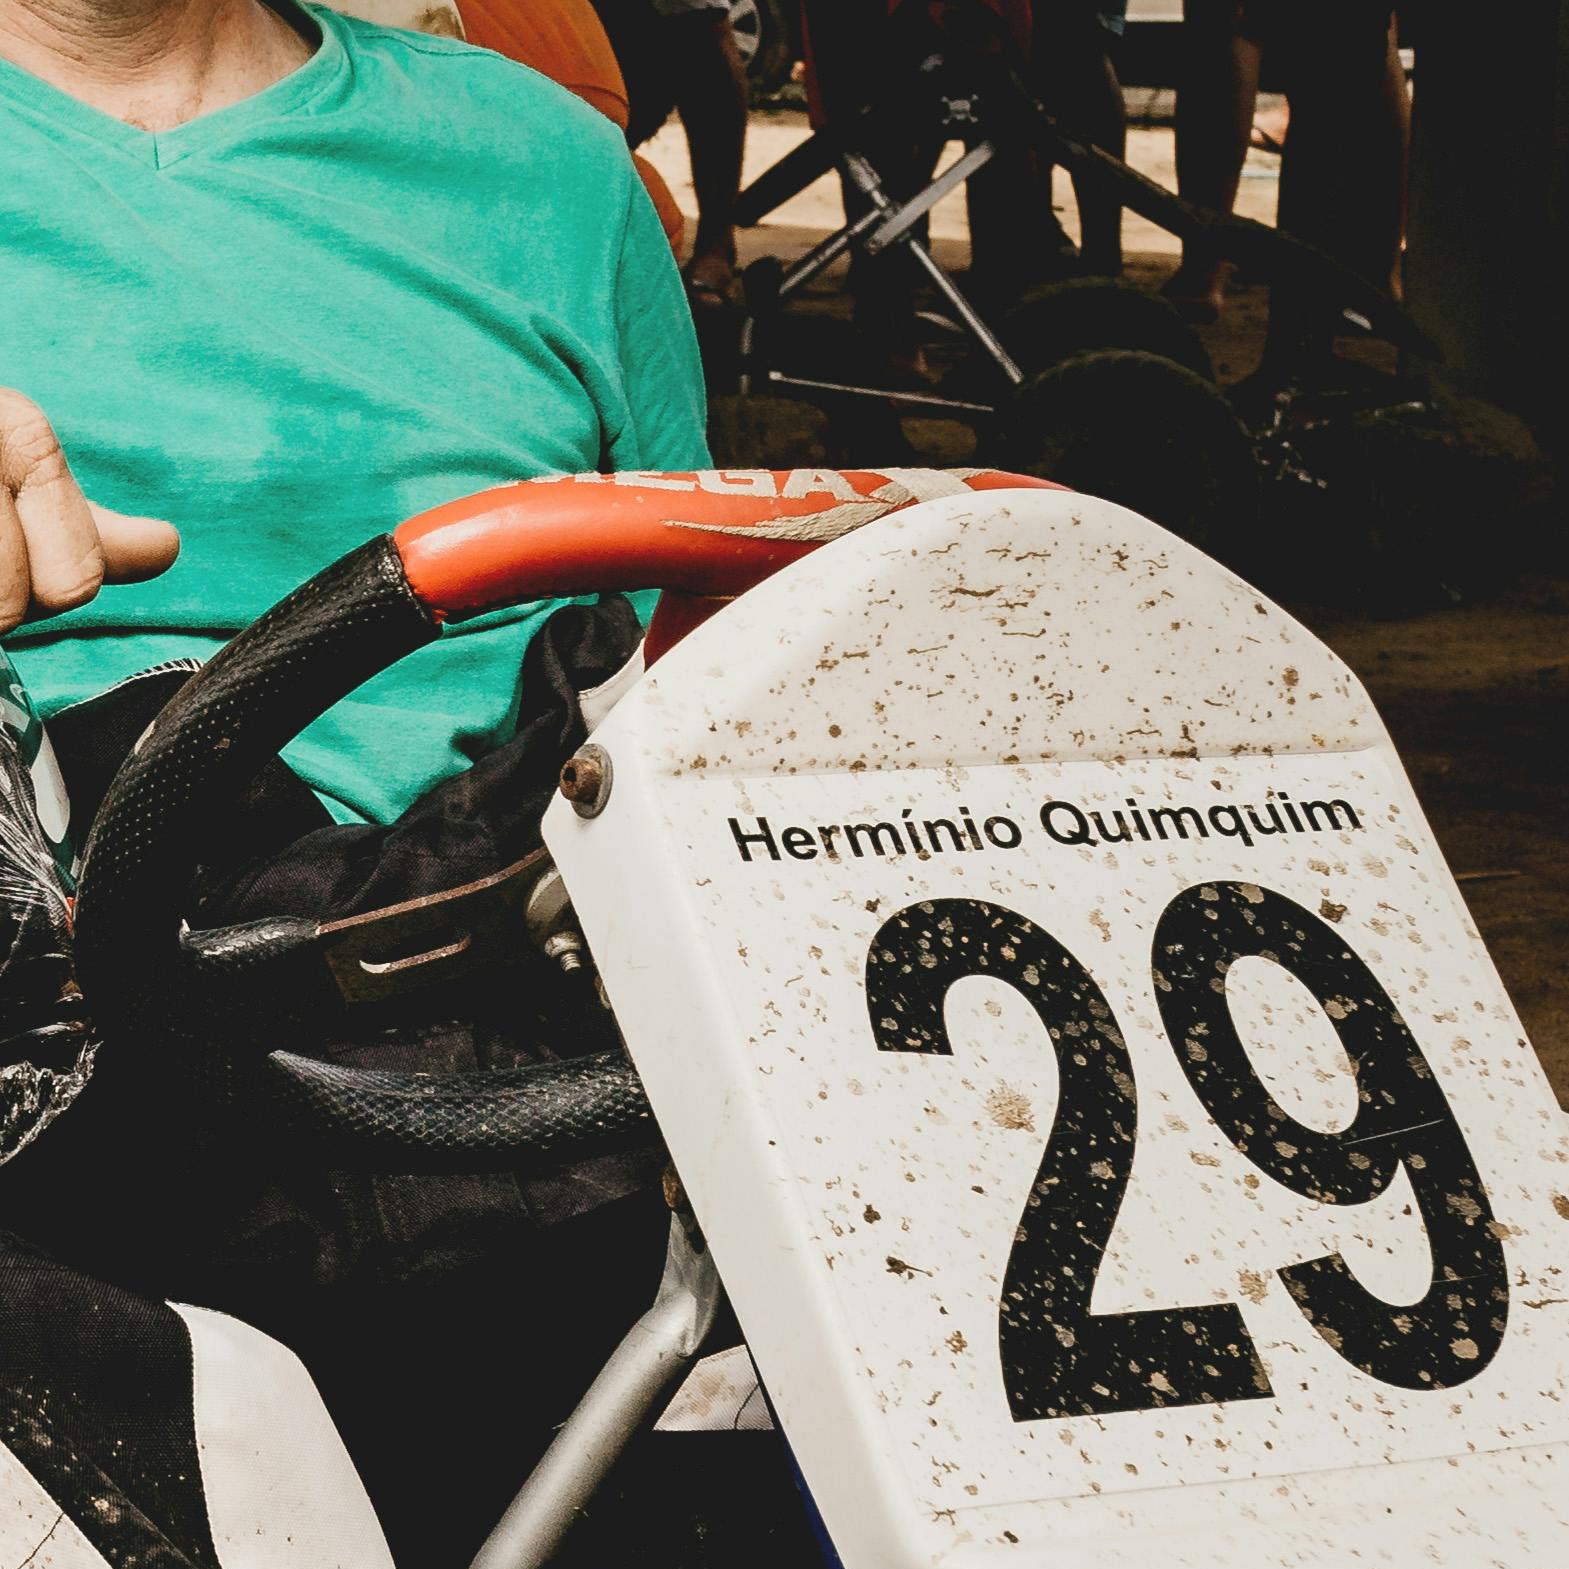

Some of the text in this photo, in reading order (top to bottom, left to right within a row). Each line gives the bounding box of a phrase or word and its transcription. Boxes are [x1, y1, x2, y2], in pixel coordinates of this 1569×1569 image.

[727, 791, 1363, 862] Hermínio Quimquim
[865, 880, 1510, 1423] 29
